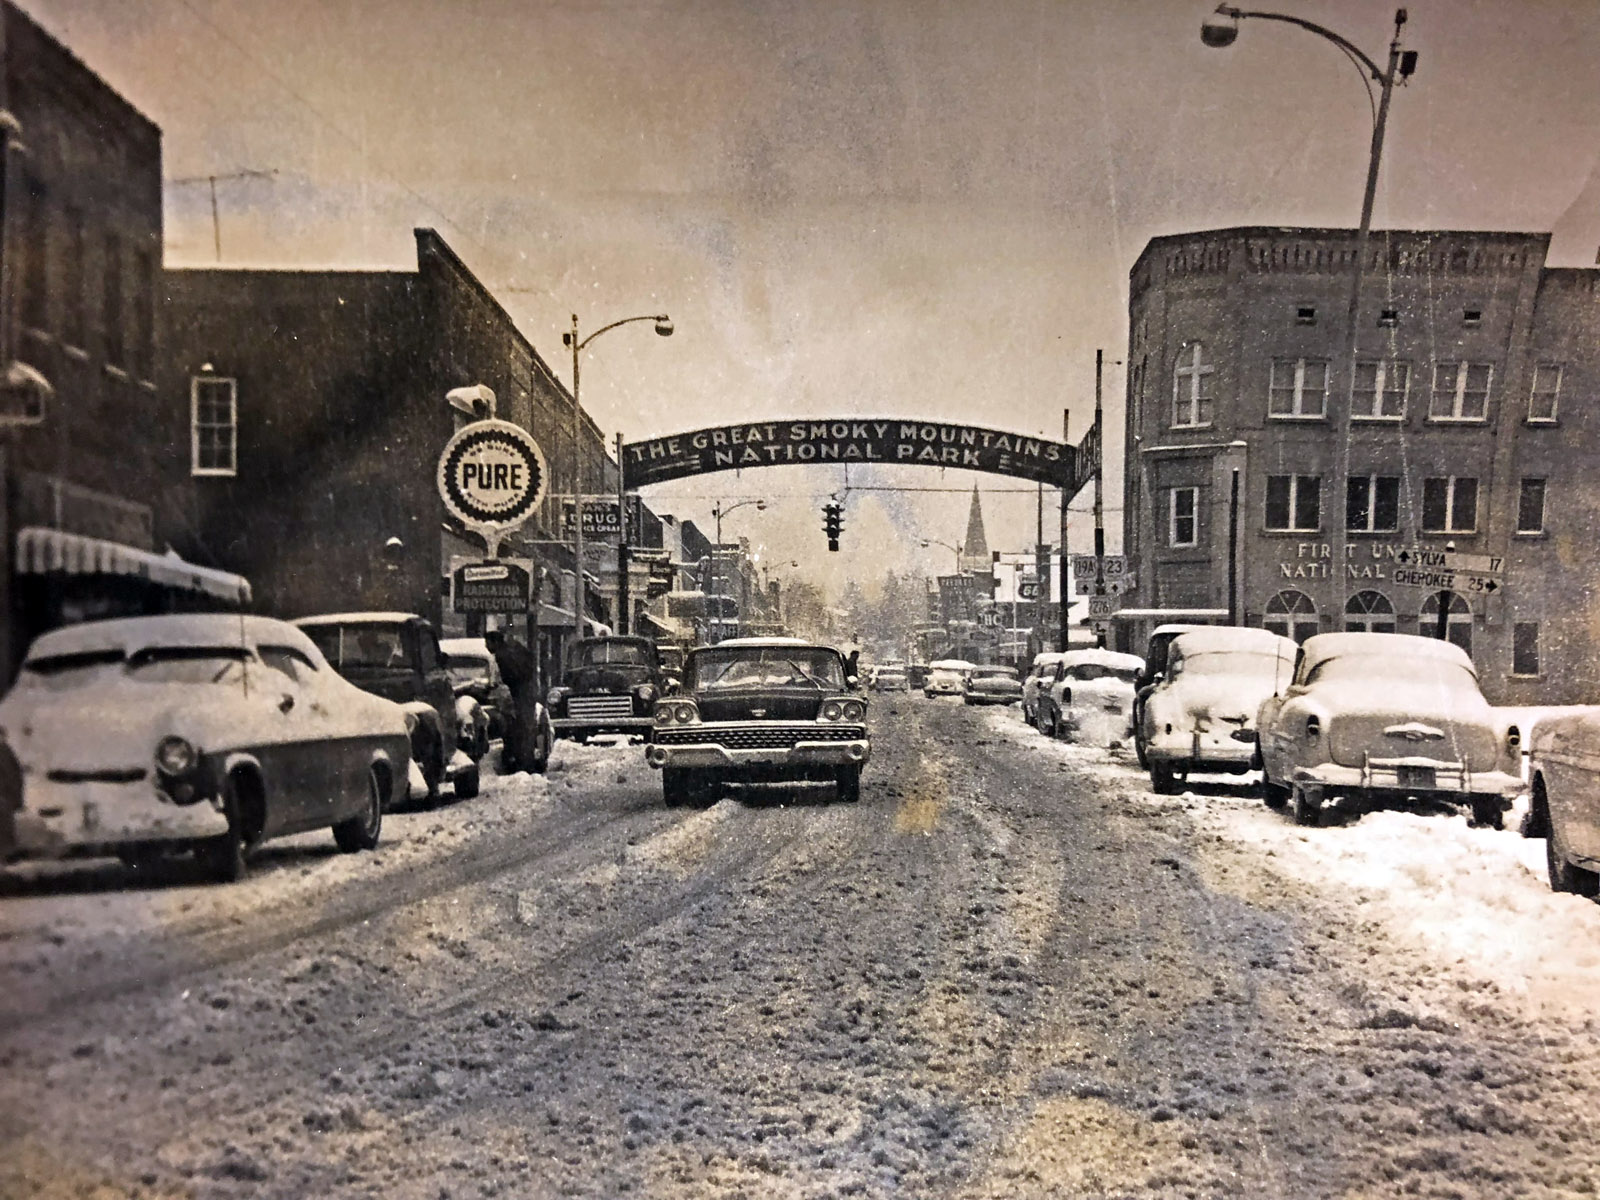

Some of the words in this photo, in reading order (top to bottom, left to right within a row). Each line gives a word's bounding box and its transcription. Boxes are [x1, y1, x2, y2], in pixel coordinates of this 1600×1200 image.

[631, 439, 682, 462] THE
[692, 425, 777, 449] GREAT
[789, 423, 888, 441] SMOKY
[900, 424, 1060, 461] MOUNTAINS
[714, 443, 881, 466] NATIONAL
[897, 444, 980, 466] PARK
[463, 463, 523, 490] PURE
[1298, 543, 1357, 558] FIRT
[1076, 560, 1095, 573] 19A
[1107, 560, 1122, 574] 23
[1412, 551, 1446, 567] SYLVA
[1489, 558, 1502, 571] 17
[1280, 563, 1386, 578] NATINAL
[1468, 578, 1484, 591] 25
[455, 598, 528, 611] PROTECTION
